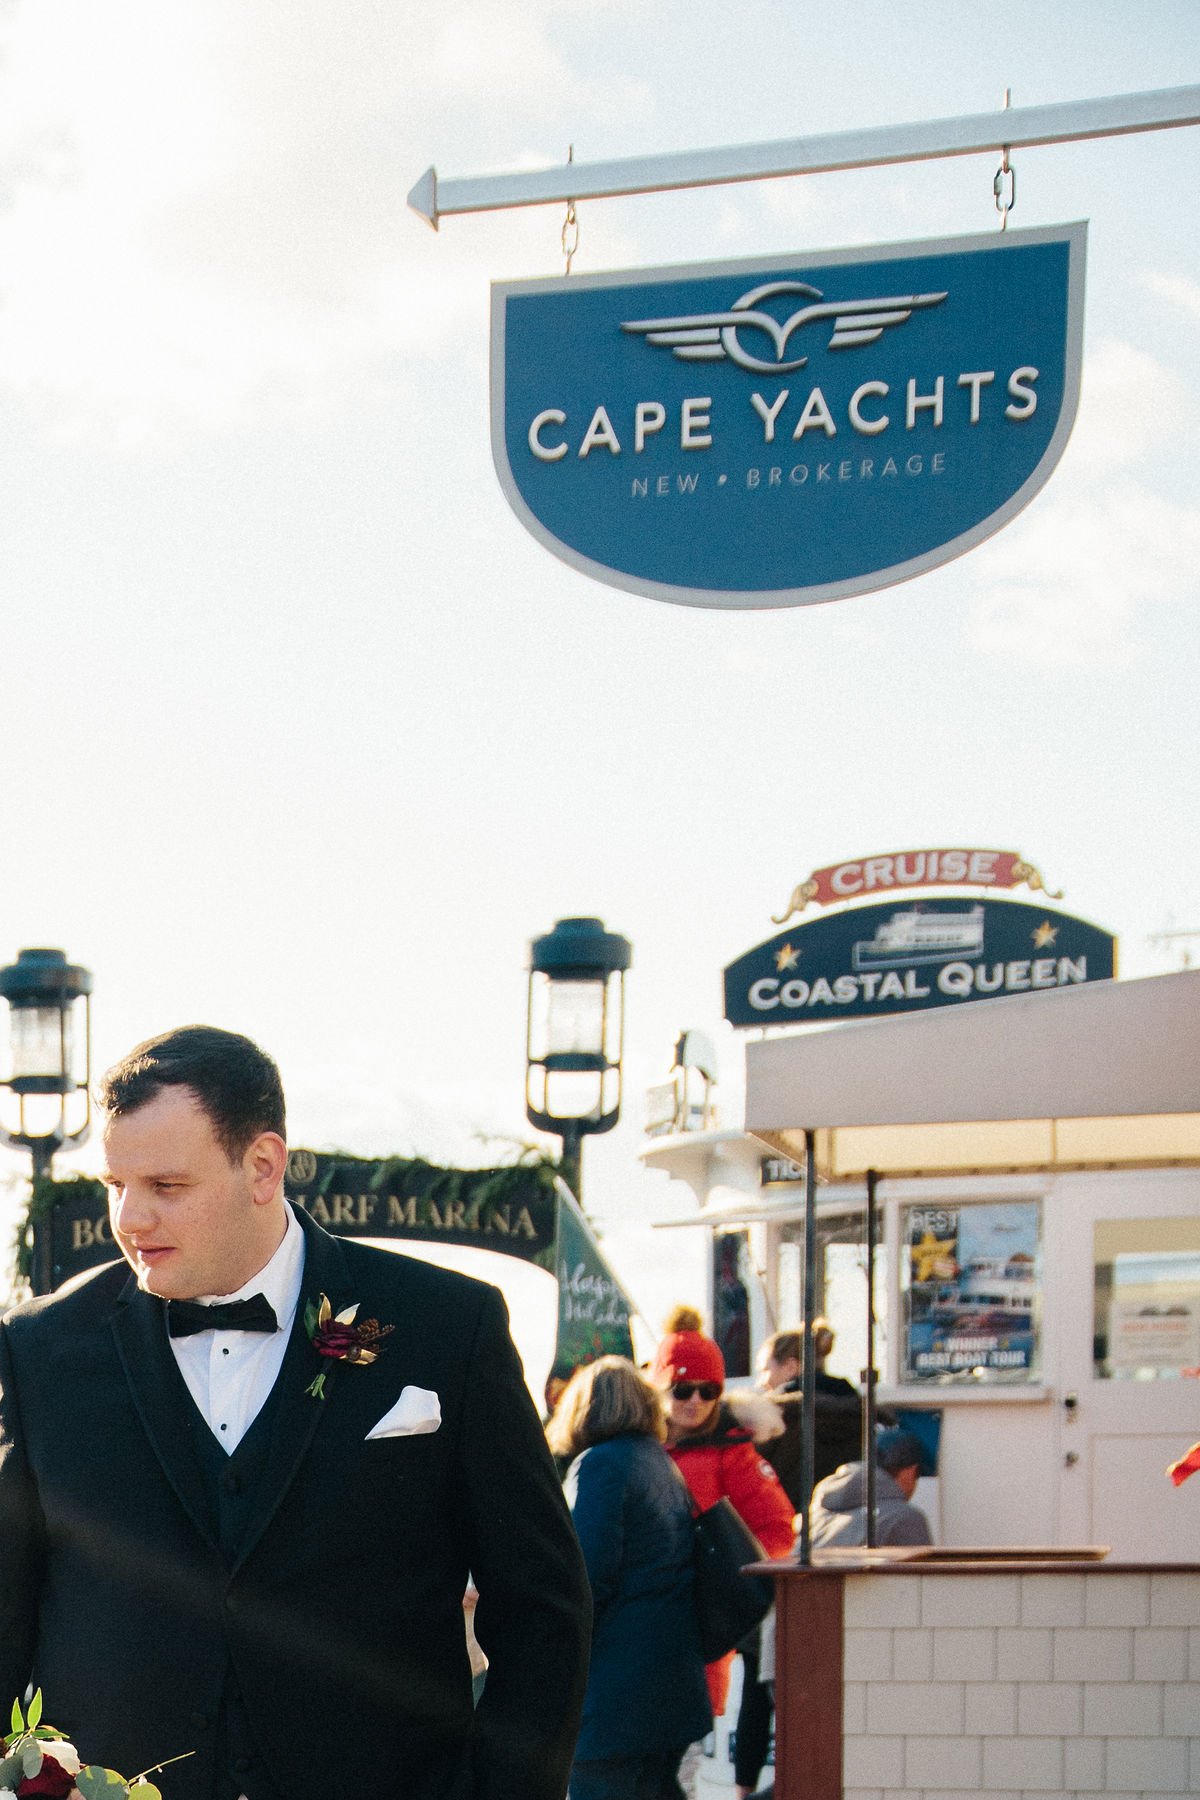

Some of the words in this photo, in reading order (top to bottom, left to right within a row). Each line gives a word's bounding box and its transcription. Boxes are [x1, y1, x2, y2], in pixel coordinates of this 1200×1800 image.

[528, 396, 713, 462] CAPE
[750, 365, 1041, 443] YACHTS
[630, 473, 701, 499] NEW
[746, 451, 949, 488] BROKERAGE
[830, 850, 1001, 896] CRUISE
[748, 970, 931, 1011] COASTAL
[937, 956, 1088, 998] QUEEN
[387, 1195, 539, 1241] MARINA
